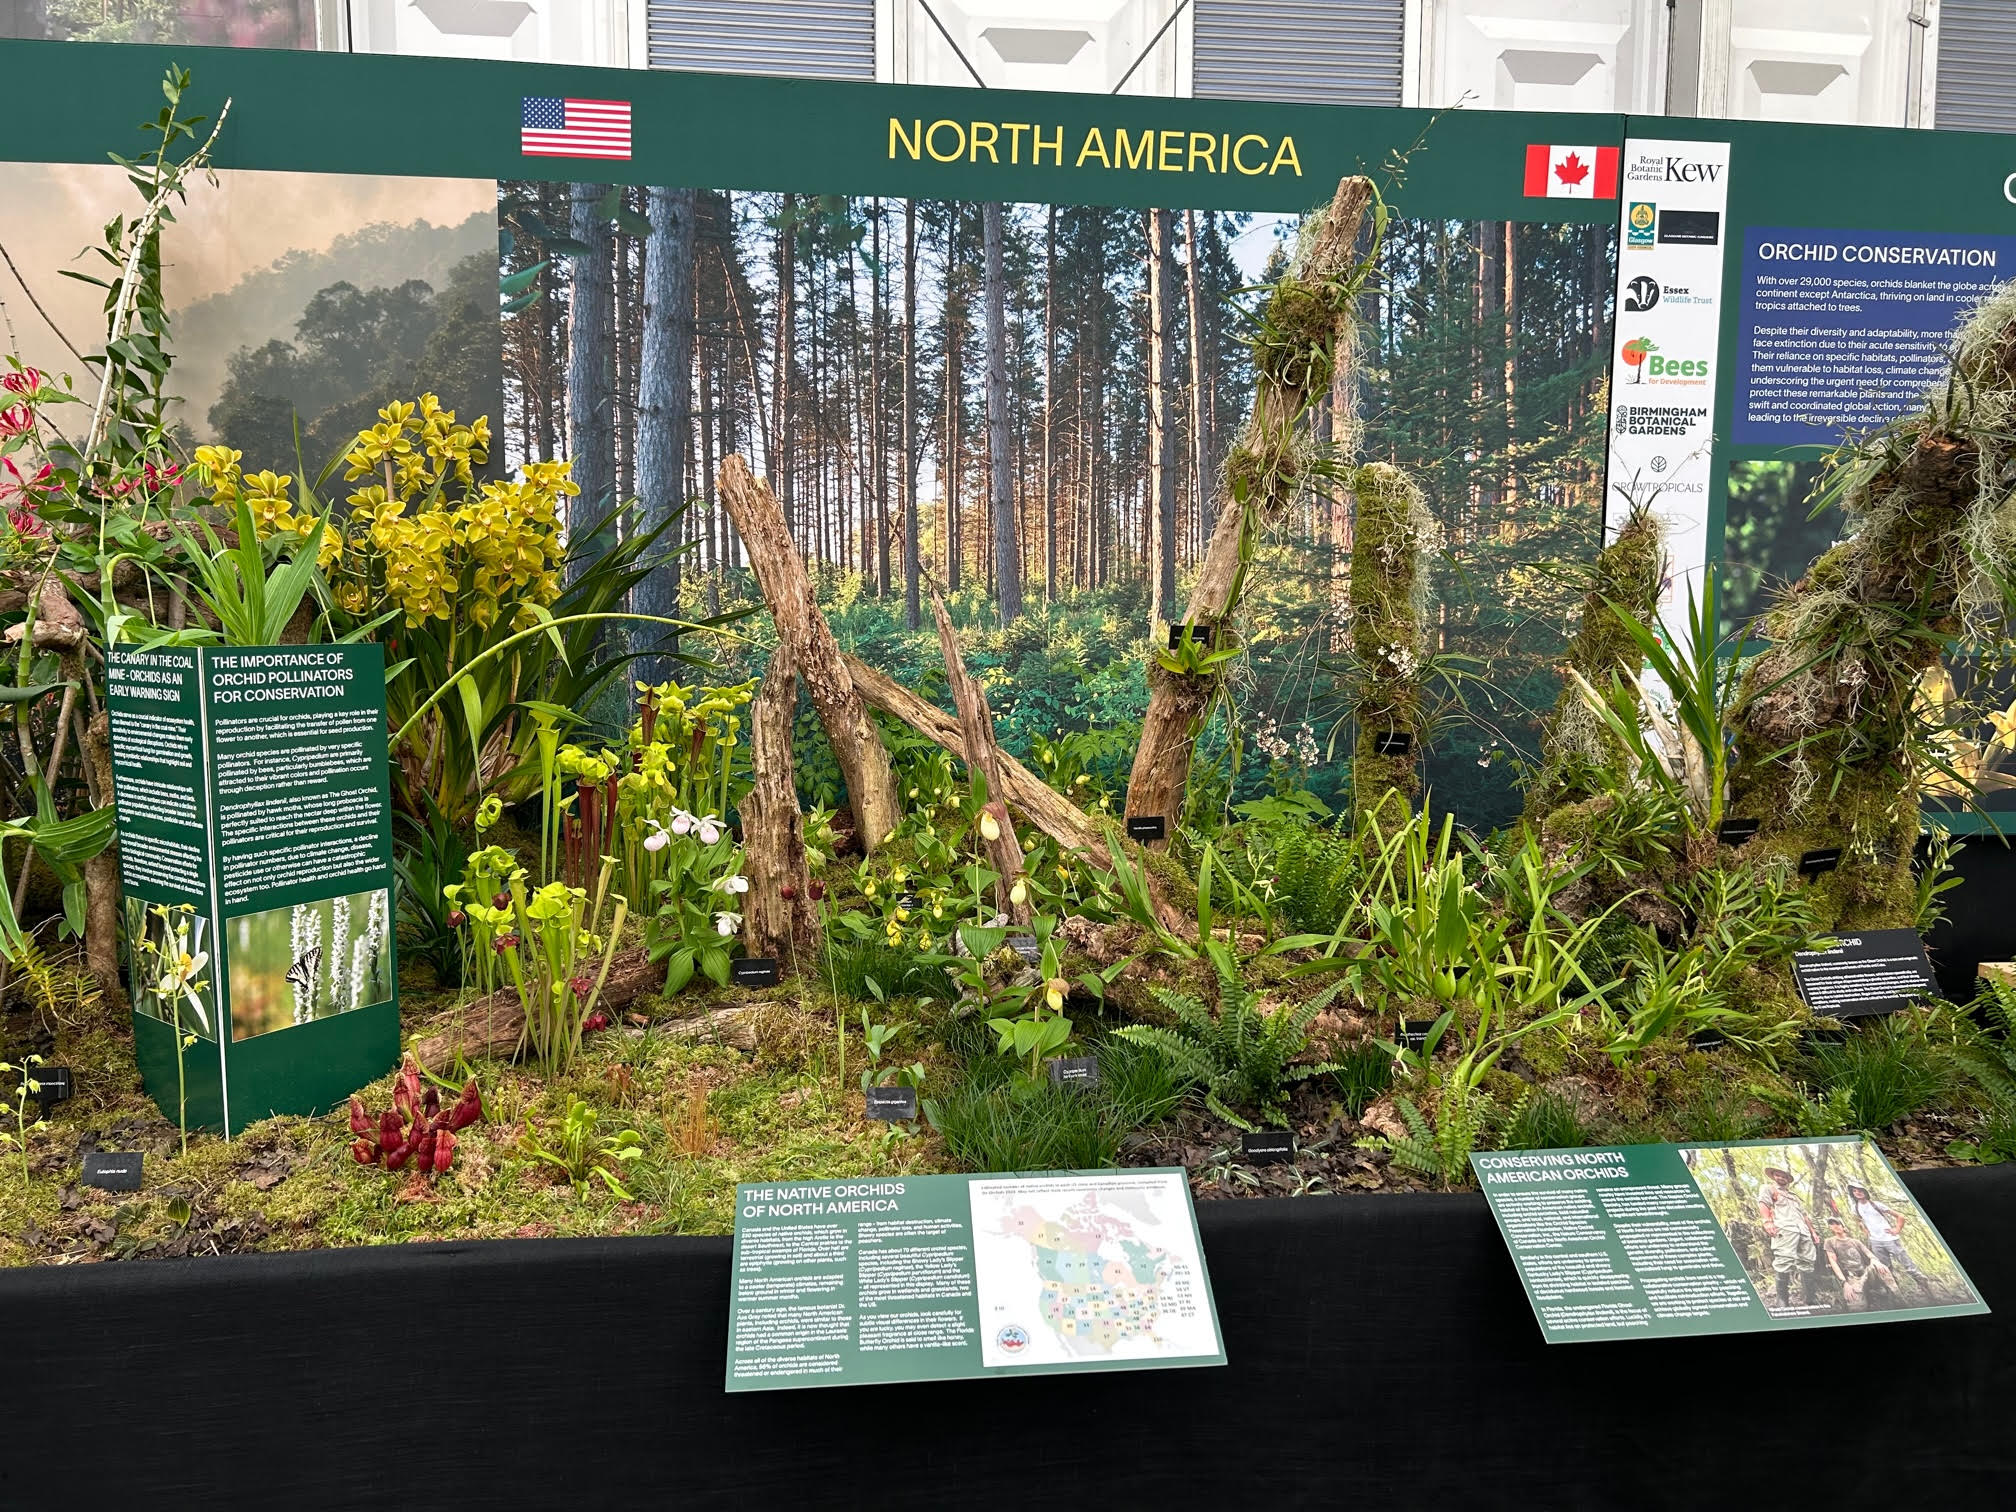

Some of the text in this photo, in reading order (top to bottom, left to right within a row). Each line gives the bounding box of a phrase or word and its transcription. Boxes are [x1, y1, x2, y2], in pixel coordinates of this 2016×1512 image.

[888, 117, 1302, 176] NORTH AMERICA
[1631, 164, 1662, 172] Botanic
[1640, 156, 1723, 182] Royal Kew
[1627, 172, 1662, 181] Gardens
[1759, 242, 1996, 266] ORCHID CONSERVATION
[1663, 286, 1689, 294] Essex
[1757, 276, 1776, 285] With
[1800, 277, 1831, 287] 29,000
[1833, 278, 1868, 289] species,
[1871, 279, 1902, 288] orchids
[1905, 280, 1936, 289] blanket
[1938, 281, 1951, 289] the
[1953, 281, 1976, 292] globe
[1756, 288, 1797, 298] continent
[1800, 289, 1829, 301] except
[1832, 290, 1877, 301] Antarctica,
[1880, 291, 1911, 303] thriving
[1927, 292, 1945, 301] land
[1947, 293, 1953, 302] in
[1756, 301, 1862, 312] tropics attached to trees.
[1754, 326, 1787, 337] Despite
[1789, 327, 1808, 336] their
[1810, 327, 1847, 338] diversity
[1849, 328, 1865, 337] and
[1867, 328, 1918, 340] adaptability,
[1753, 339, 1772, 347] face
[1774, 339, 1820, 348] extinction
[1822, 340, 1835, 348] due
[1838, 340, 1846, 348] to
[1848, 340, 1867, 349] their
[1869, 341, 1893, 349] acute
[1895, 341, 1937, 352] sensitivity
[1752, 351, 1774, 360] Their
[1776, 352, 1810, 360] reliance
[1826, 352, 1859, 363] specific
[1862, 353, 1897, 363] habitats,
[1649, 355, 1708, 377] Bees
[1752, 364, 1773, 372] them
[1775, 364, 1820, 373] vulnerable
[1823, 364, 1831, 373] to
[1833, 365, 1862, 373] habitat
[1865, 365, 1883, 375] loss,
[1886, 365, 1916, 374] climate
[1751, 376, 1808, 387] underscoring
[1811, 377, 1824, 385] the
[1826, 377, 1854, 388] urgent
[1856, 377, 1877, 386] need
[1880, 378, 1891, 386] for
[1750, 388, 1781, 399] protect
[1784, 389, 1807, 397] these
[1809, 389, 1857, 398] remarkable
[1860, 390, 1886, 400] plants
[1888, 390, 1903, 398] and
[1629, 407, 1707, 417] BIRMINGHAM
[1749, 400, 1769, 409] swift
[1772, 401, 1788, 409] and
[1790, 401, 1842, 410] coordinated
[1844, 402, 1871, 412] global
[1629, 417, 1696, 426] BOTANICAL
[1748, 413, 1780, 423] leading
[1782, 413, 1791, 421] to
[1809, 413, 1856, 422] irreversible
[1629, 426, 1686, 435] GARDENS
[1612, 482, 1703, 492] GROWTROPICALS
[108, 652, 193, 668] THE CANARY IN THE COAL
[212, 653, 344, 668] THE IMPORTANCE OF
[109, 668, 125, 680] MINE
[130, 670, 160, 683] ORCHIDS
[162, 673, 171, 684] AS
[172, 673, 182, 685] AN
[213, 669, 353, 686] ORCHID POLLINATORS
[110, 684, 180, 702] EARLY WARNING SIGN
[214, 685, 344, 703] FOR CONSERVATION
[215, 718, 247, 726] Pollinators
[289, 713, 312, 721] orchids,
[313, 712, 333, 720] playing
[339, 710, 348, 718] key
[217, 753, 234, 762] Many
[256, 749, 279, 758] species
[291, 745, 319, 755] pollinated
[341, 741, 362, 750] specific
[1479, 1152, 1625, 1169] CONSERVING NORTH
[1487, 1167, 1629, 1184] AMERICAN ORCHIDS
[744, 1183, 905, 1202] THE NATIVE ORCHIDS
[743, 1200, 898, 1218] OF NORTH AMERICA
